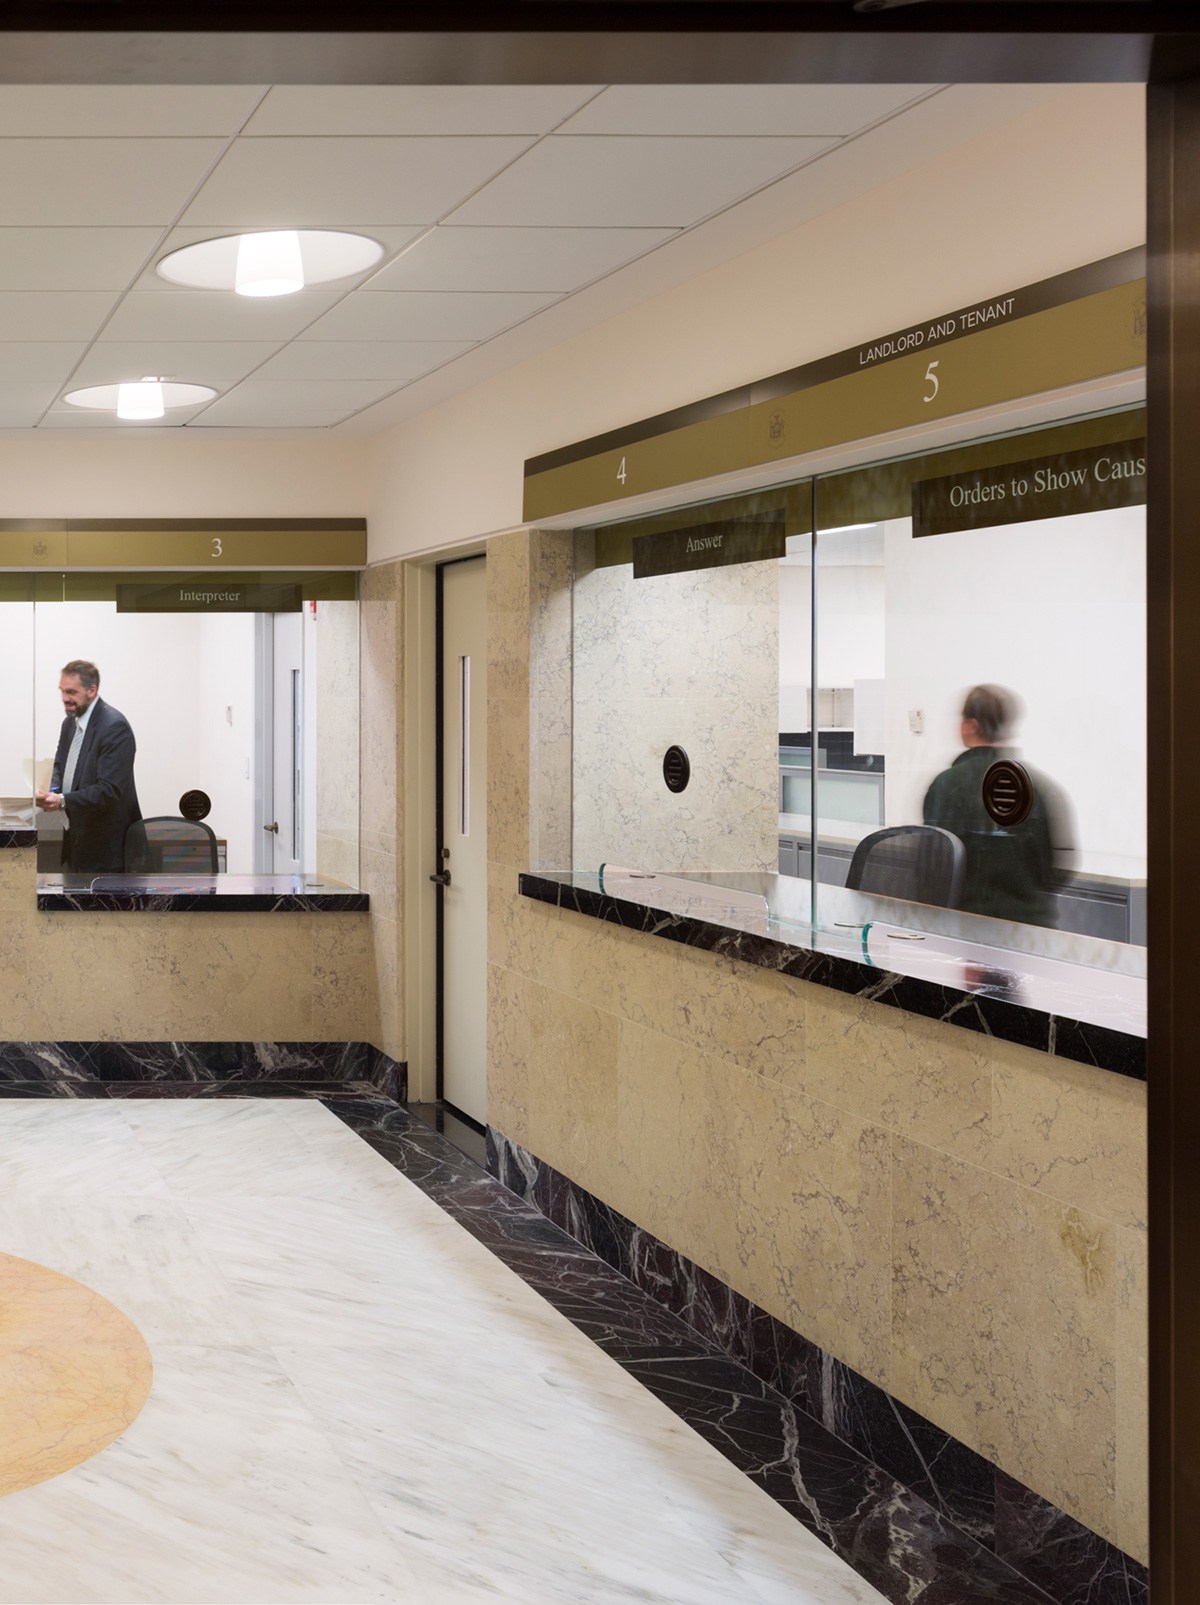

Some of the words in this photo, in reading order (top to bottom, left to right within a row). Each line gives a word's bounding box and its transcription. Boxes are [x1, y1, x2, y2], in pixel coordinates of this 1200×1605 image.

[859, 330, 924, 365] LANDLORD
[927, 319, 956, 342] AND
[959, 297, 1016, 330] TENANT
[923, 360, 940, 403] 5
[616, 456, 627, 485] 4
[950, 481, 1006, 507] Orders
[1011, 478, 1029, 497] to
[1034, 467, 1088, 493] Show
[1094, 457, 1146, 482] Caus
[210, 537, 223, 558] 3
[685, 534, 724, 553] Answer
[179, 589, 241, 604] Interpreter
